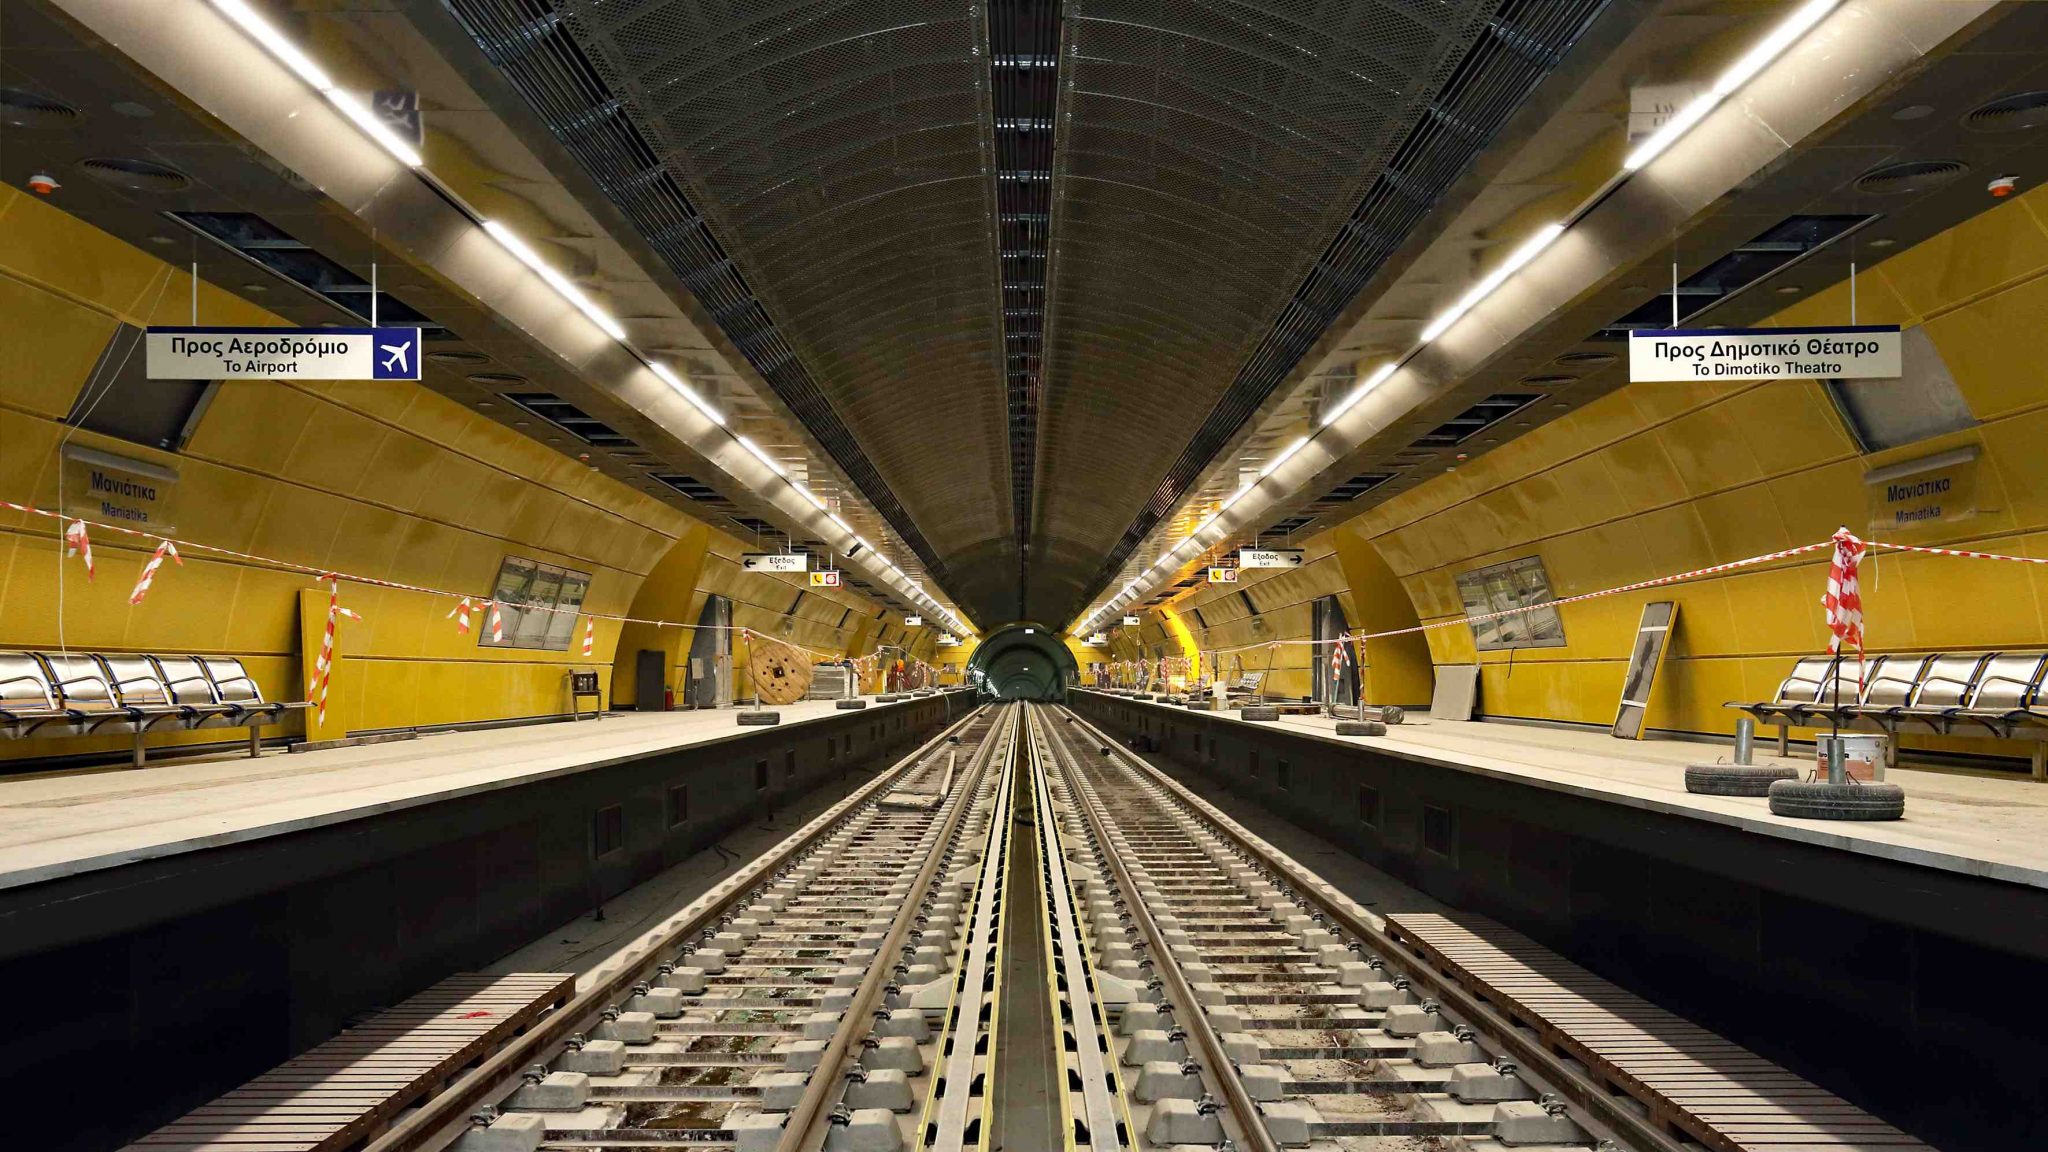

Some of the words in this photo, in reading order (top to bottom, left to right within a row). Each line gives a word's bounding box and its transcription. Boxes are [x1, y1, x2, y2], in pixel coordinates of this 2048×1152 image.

[171, 337, 223, 357] Προς
[228, 337, 349, 357] Αεροδρόμιο
[1655, 342, 1705, 361] Προς
[1710, 340, 1800, 360] Δημοτικό
[1806, 338, 1880, 358] Θέατρο
[223, 360, 241, 373] To
[245, 360, 298, 375] Airport
[1692, 363, 1710, 376] To
[1714, 362, 1781, 375] Dimotiko
[1785, 361, 1842, 374] Theatro
[92, 471, 156, 501] Μανιάτικα
[1887, 478, 1951, 502] Μανιάτικα
[101, 502, 148, 522] Maniatika
[1896, 506, 1941, 524] Maniatika
